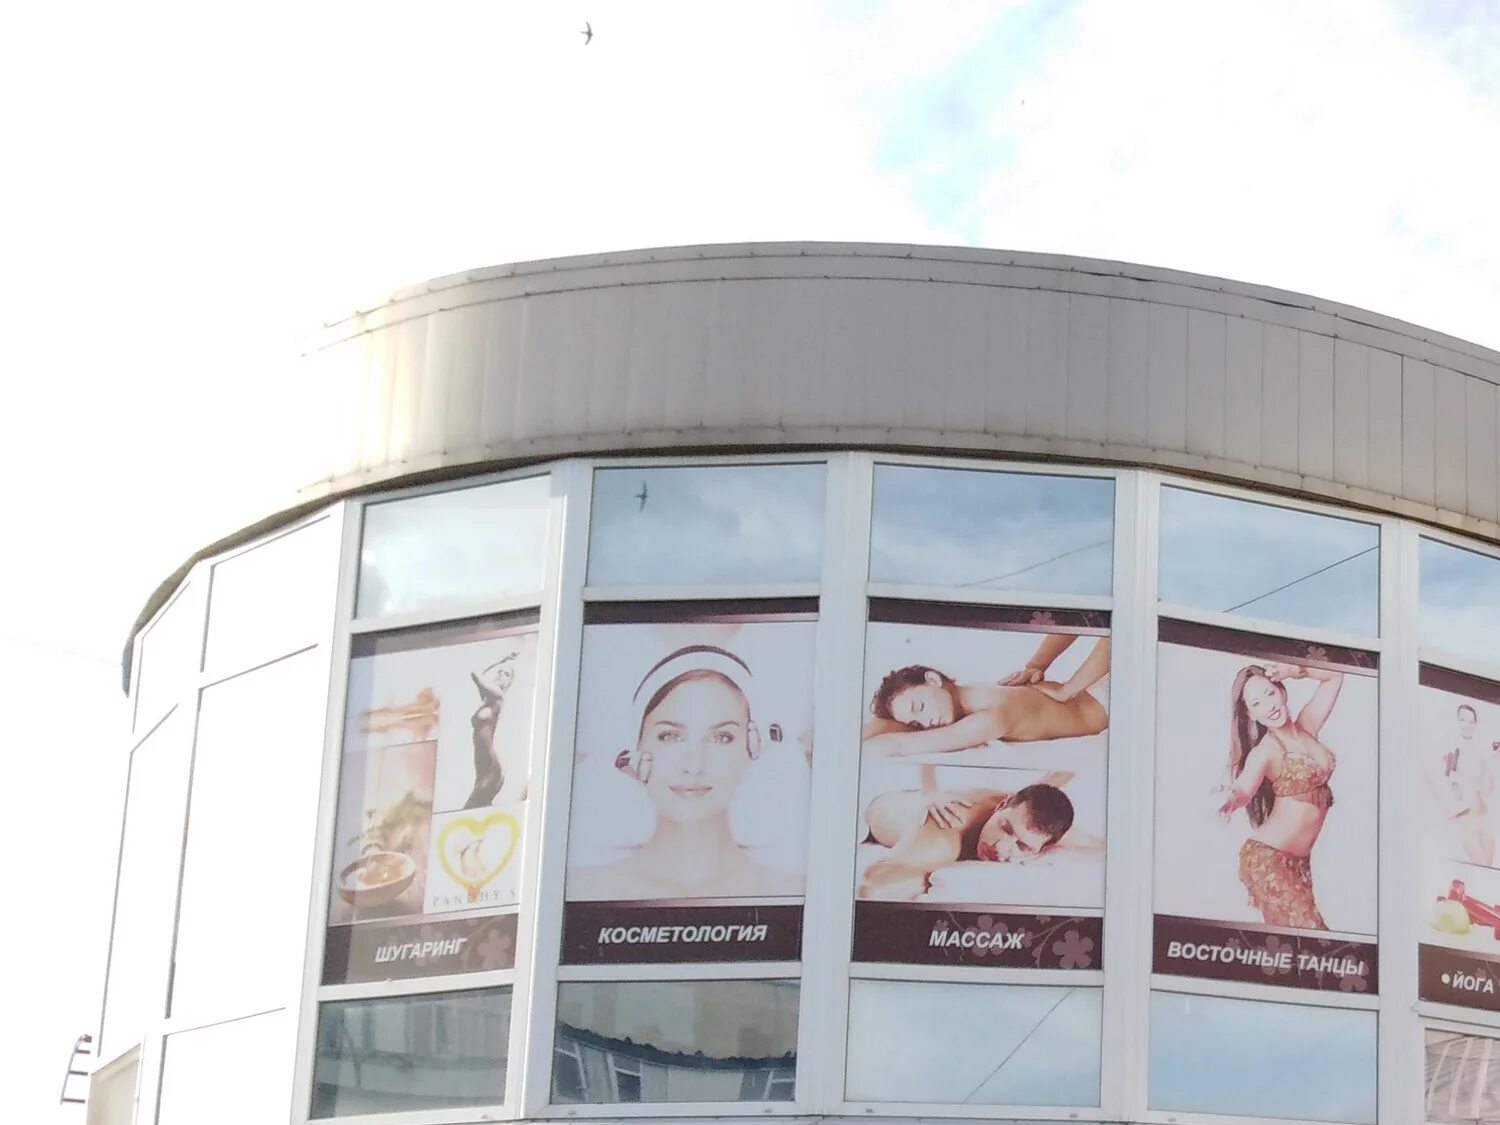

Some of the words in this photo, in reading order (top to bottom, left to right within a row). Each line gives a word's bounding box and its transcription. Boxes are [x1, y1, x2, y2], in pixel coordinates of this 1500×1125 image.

[598, 925, 767, 944] КОСМЕТОЛОГИЯ
[928, 930, 1025, 949] МАССАЖ
[374, 938, 468, 963] ШУГАРИНГ
[1167, 941, 1292, 970] ВОСТОЧНЫЕ
[1298, 953, 1365, 977] ТАНЦЫ
[1452, 974, 1495, 994] ЙОГА
